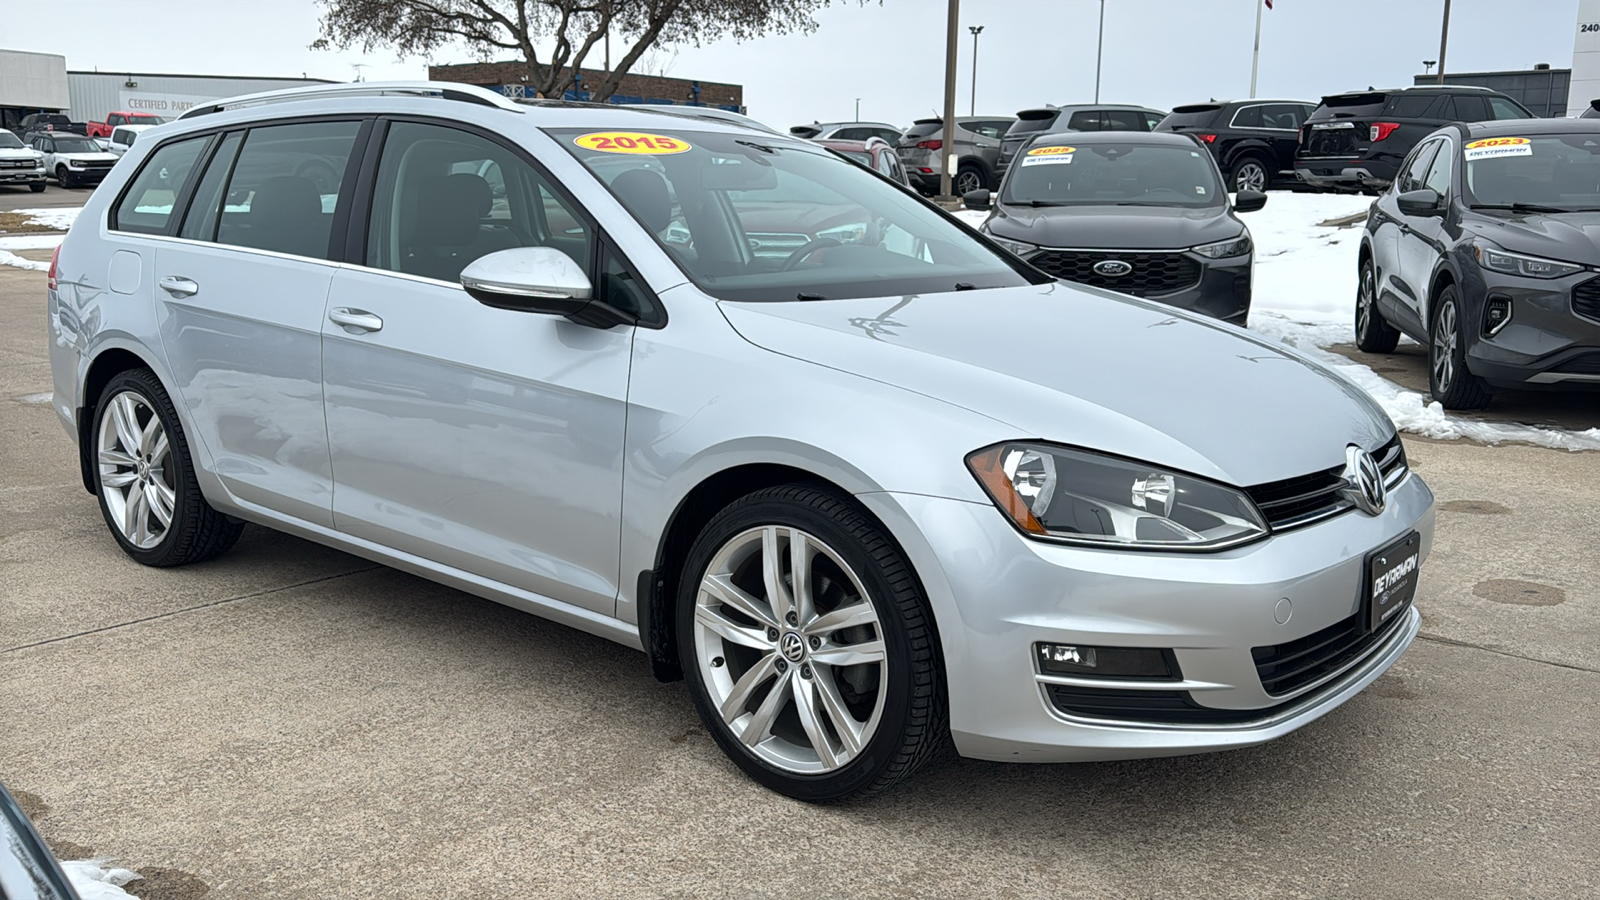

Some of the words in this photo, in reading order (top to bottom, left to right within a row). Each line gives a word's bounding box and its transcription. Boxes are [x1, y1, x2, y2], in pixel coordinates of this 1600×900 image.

[1581, 24, 1600, 33] 240
[128, 98, 168, 110] CERTIFIED
[590, 136, 679, 149] 2015
[1473, 138, 1525, 149] 2023
[1032, 147, 1070, 155] 2025
[1373, 552, 1419, 599] DEYARMAN
